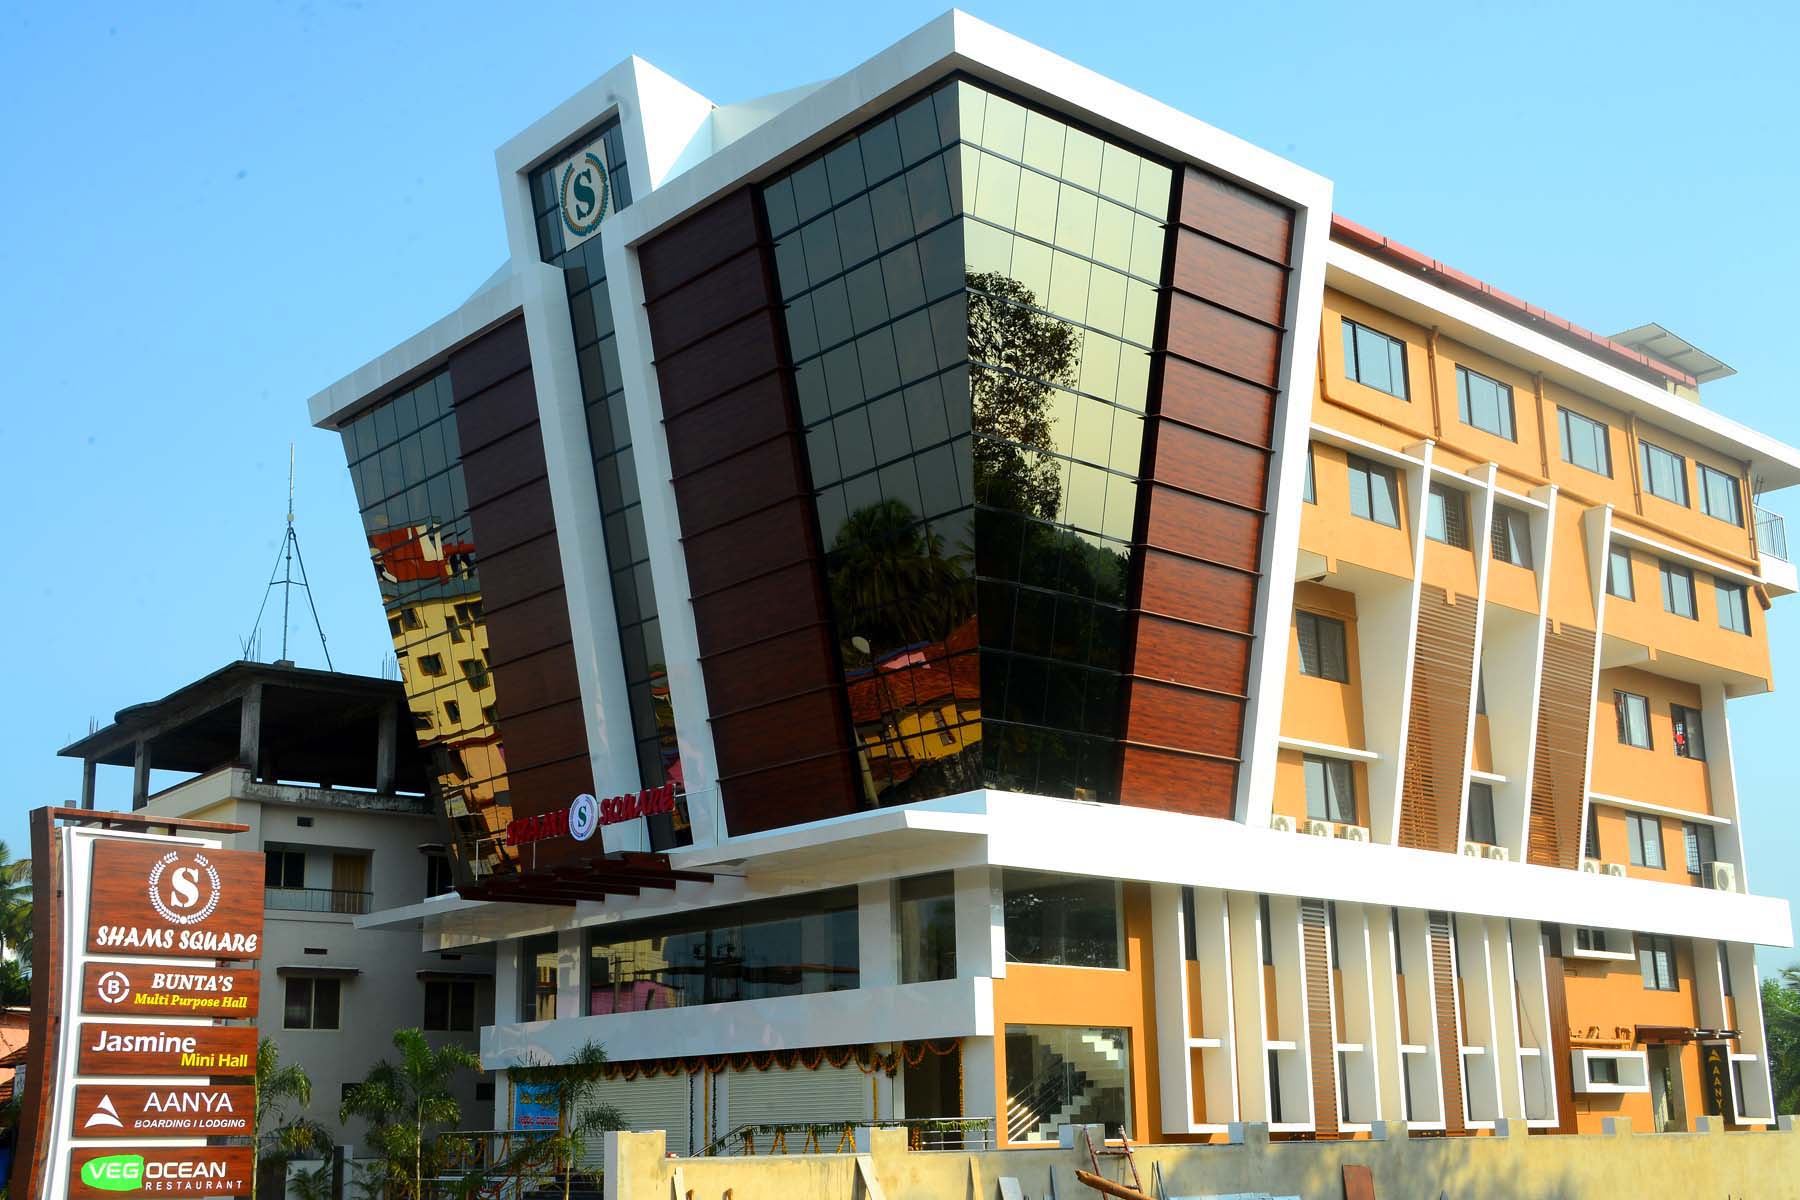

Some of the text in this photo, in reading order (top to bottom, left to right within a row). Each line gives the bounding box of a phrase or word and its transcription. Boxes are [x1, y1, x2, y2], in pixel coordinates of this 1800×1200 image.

[574, 168, 595, 220] S
[171, 867, 199, 907] S
[96, 925, 258, 953] SHAMS SQUARE
[107, 980, 120, 994] B
[152, 974, 233, 992] BUNTA'S
[134, 993, 248, 1010] Multi Purpose Hall
[92, 1030, 197, 1053] Jasmine
[180, 1053, 248, 1068] Mini Hall
[143, 1092, 234, 1112] AANYA
[134, 1119, 192, 1128] BOARDING
[198, 1119, 246, 1128] LODGING
[90, 1162, 226, 1179] VEG OCEAN
[145, 1180, 243, 1190] RESTAURANT
